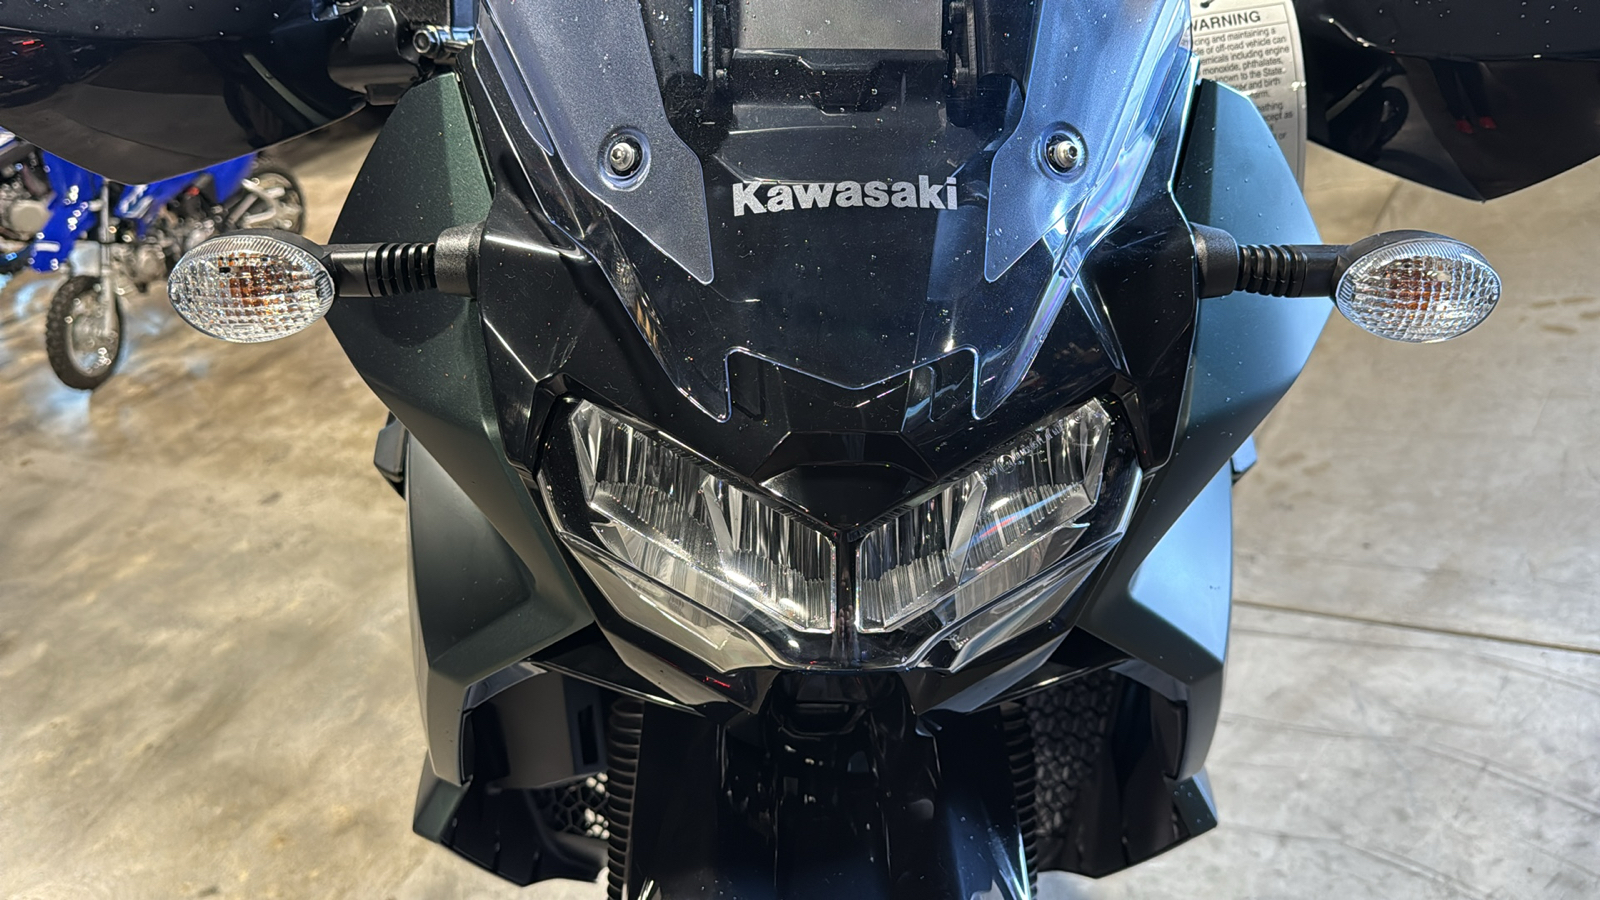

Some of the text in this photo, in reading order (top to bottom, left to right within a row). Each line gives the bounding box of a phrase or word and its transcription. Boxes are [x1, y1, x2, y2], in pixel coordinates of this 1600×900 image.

[1212, 33, 1226, 43] and
[1227, 27, 1270, 41] maintaining
[1215, 42, 1245, 53] off-road
[1246, 38, 1271, 49] vehicle
[1272, 36, 1287, 45] can
[1231, 48, 1264, 61] including
[1265, 45, 1289, 57] engine
[1240, 71, 1248, 80] to
[1249, 69, 1262, 79] the
[1248, 80, 1263, 89] and
[1263, 77, 1281, 88] birth
[1284, 110, 1293, 119] as
[732, 175, 958, 217] Kawasaki
